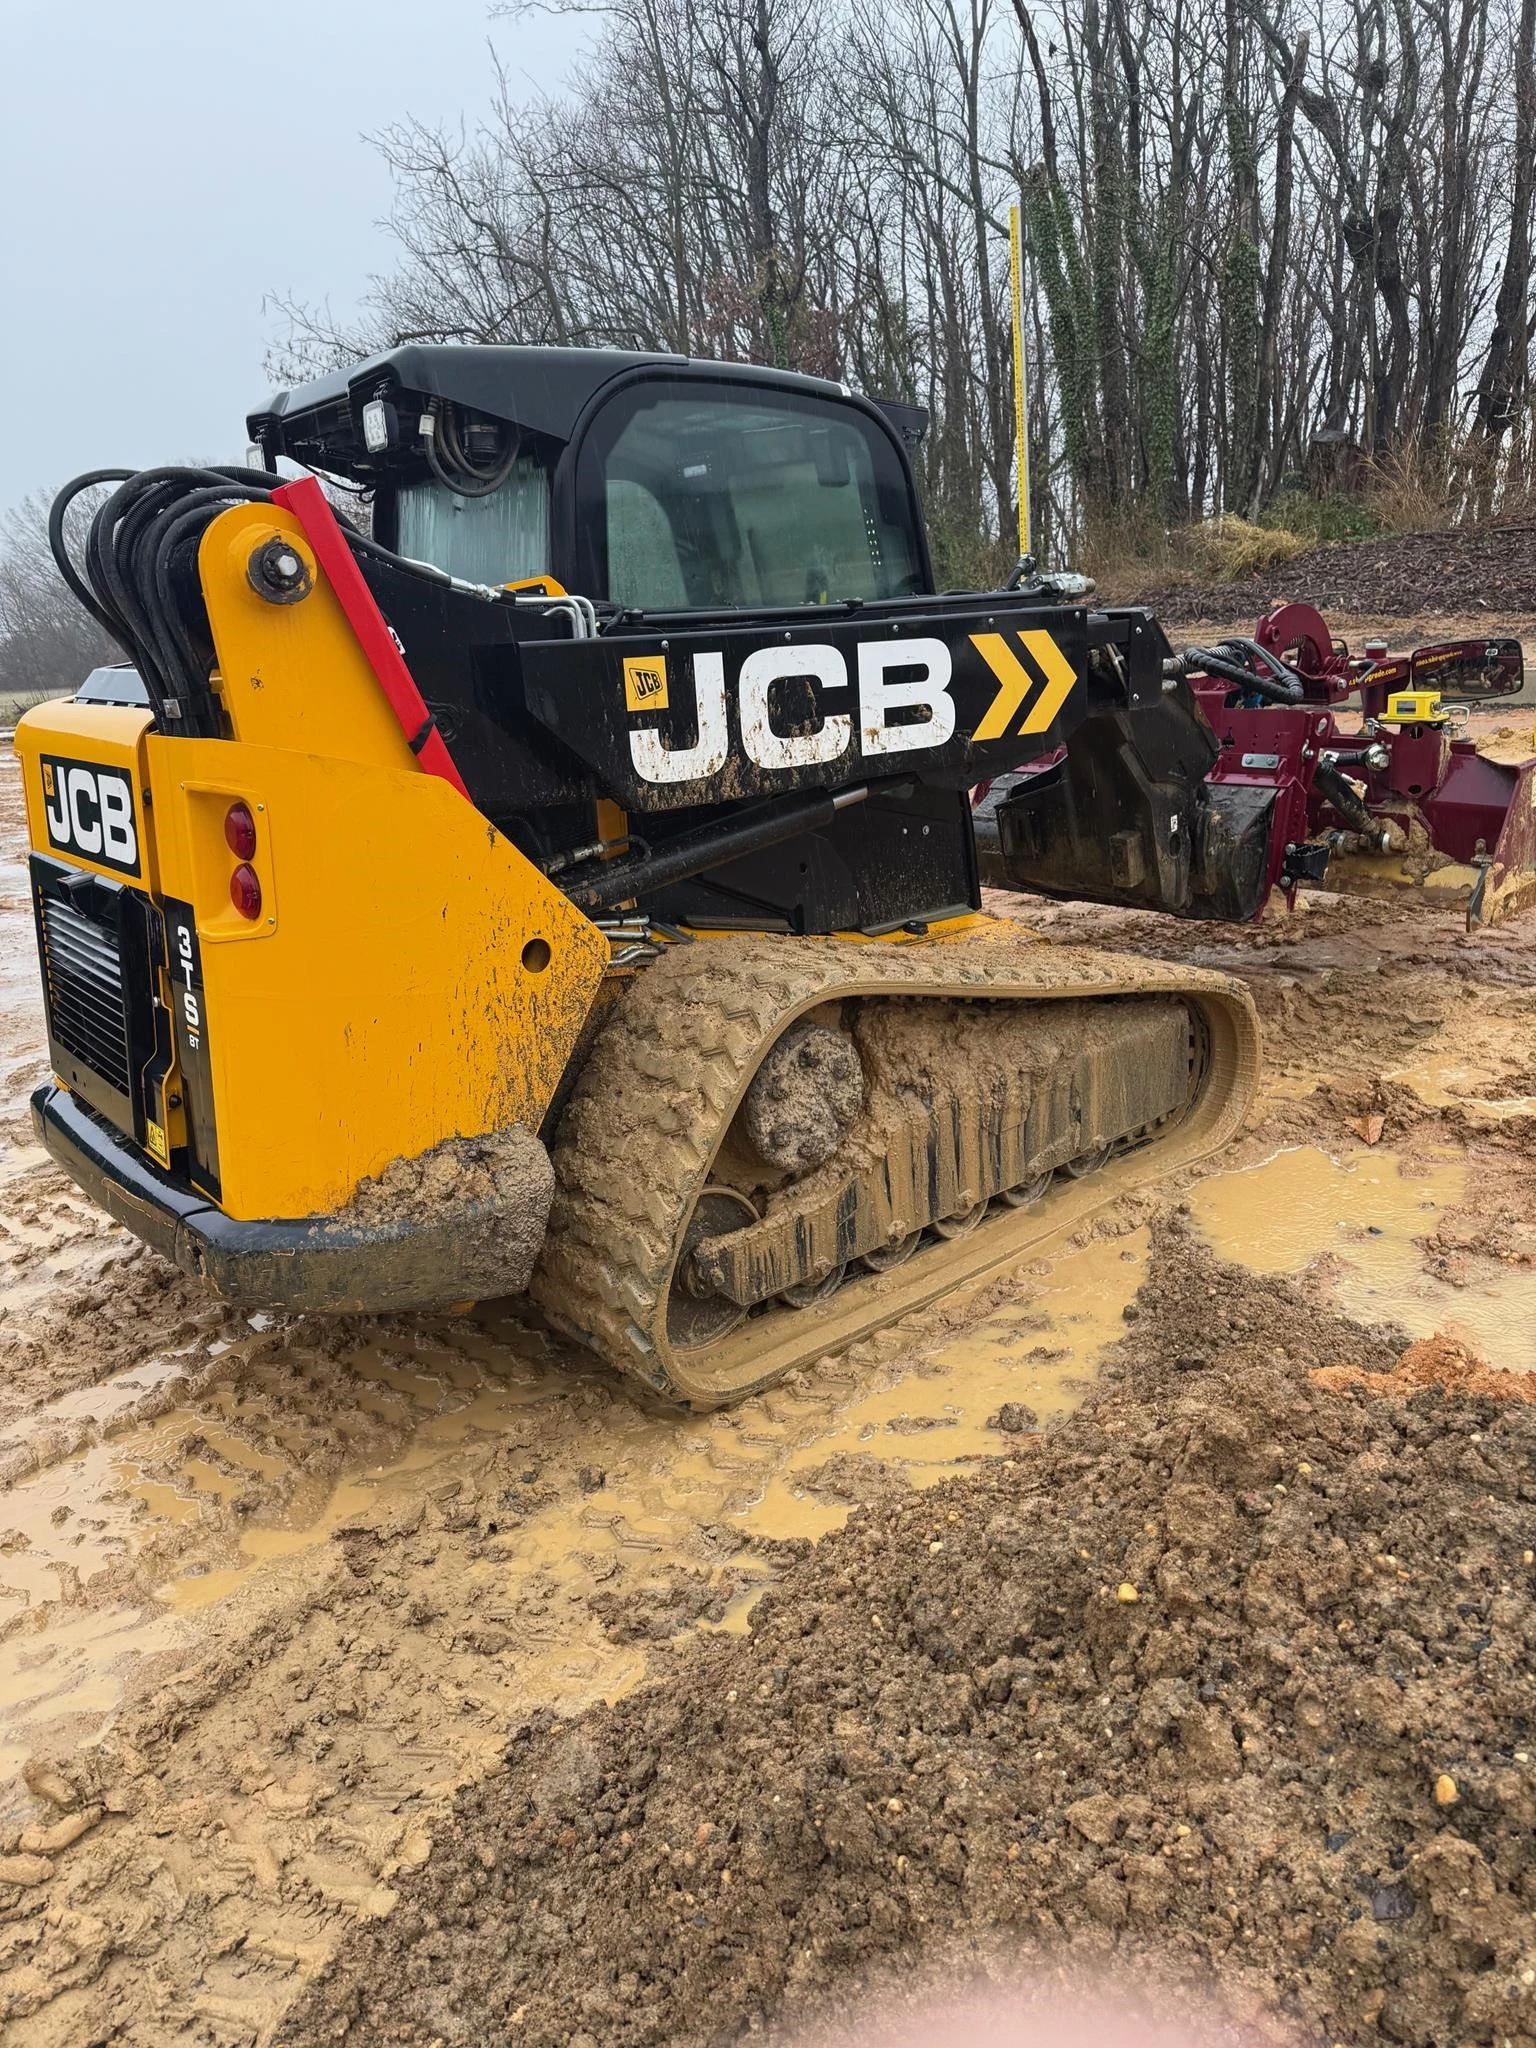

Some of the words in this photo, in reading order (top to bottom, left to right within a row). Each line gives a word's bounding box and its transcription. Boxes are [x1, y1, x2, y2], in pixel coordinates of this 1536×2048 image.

[629, 637, 956, 784] JCB
[635, 672, 661, 697] JCB
[47, 766, 137, 865] JCB
